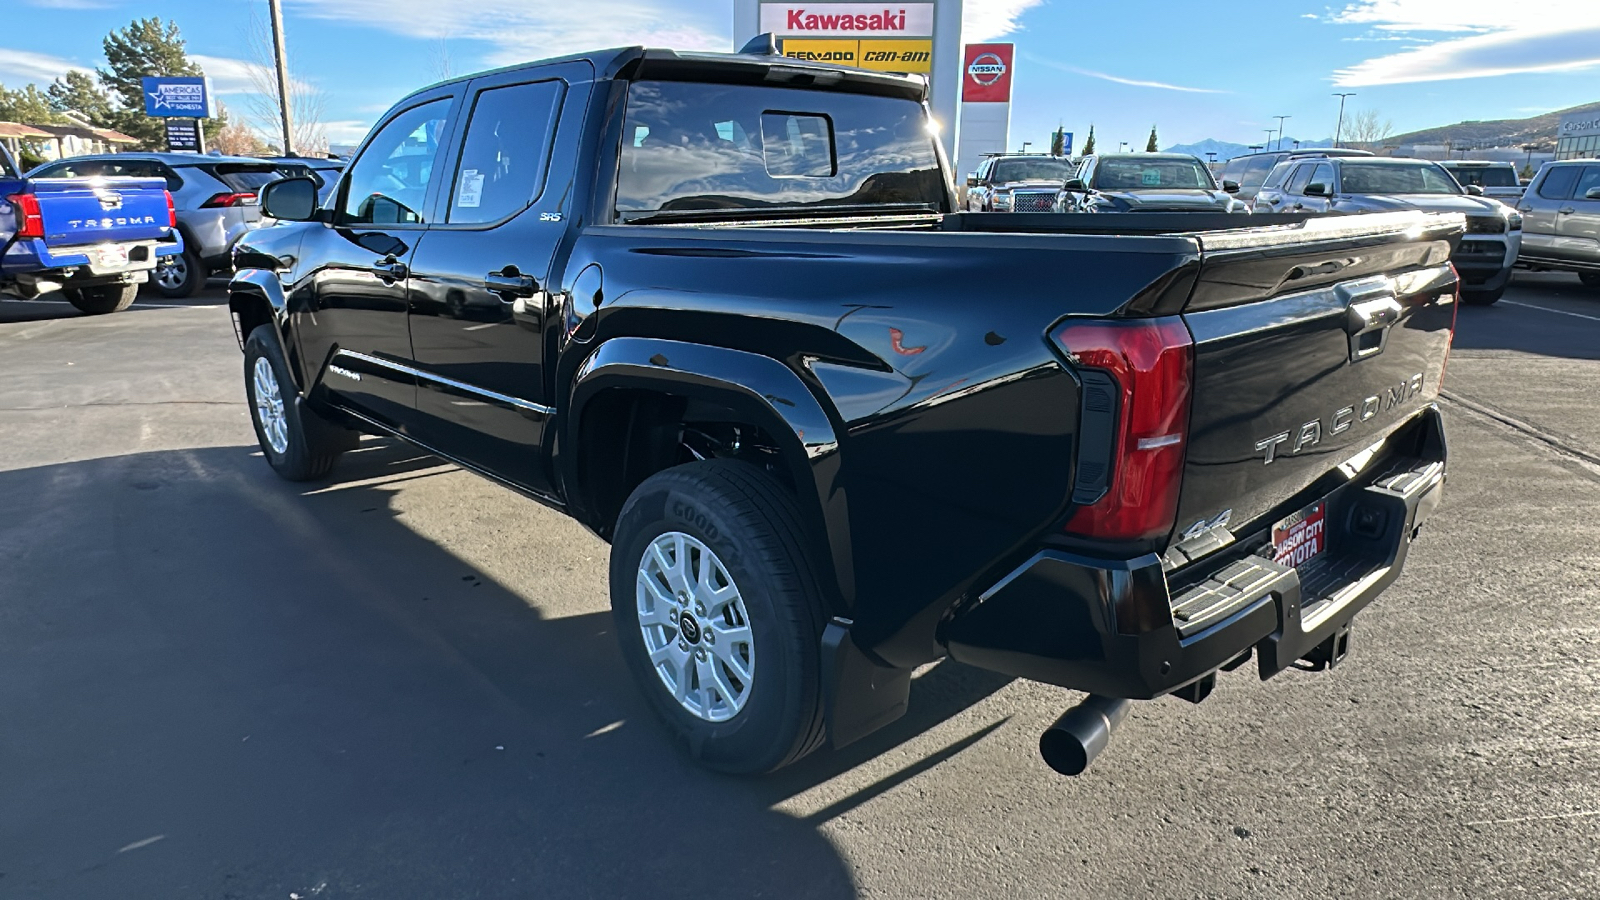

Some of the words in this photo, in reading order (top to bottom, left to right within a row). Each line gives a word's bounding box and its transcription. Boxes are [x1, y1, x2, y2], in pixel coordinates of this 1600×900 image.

[787, 9, 906, 31] Kawasaki
[863, 51, 930, 62] can-am
[164, 86, 201, 95] AMERICAS
[1563, 121, 1591, 131] Carson
[68, 216, 155, 229] TACOMA
[1254, 372, 1425, 465] TACOMA
[1306, 518, 1324, 540] CITY
